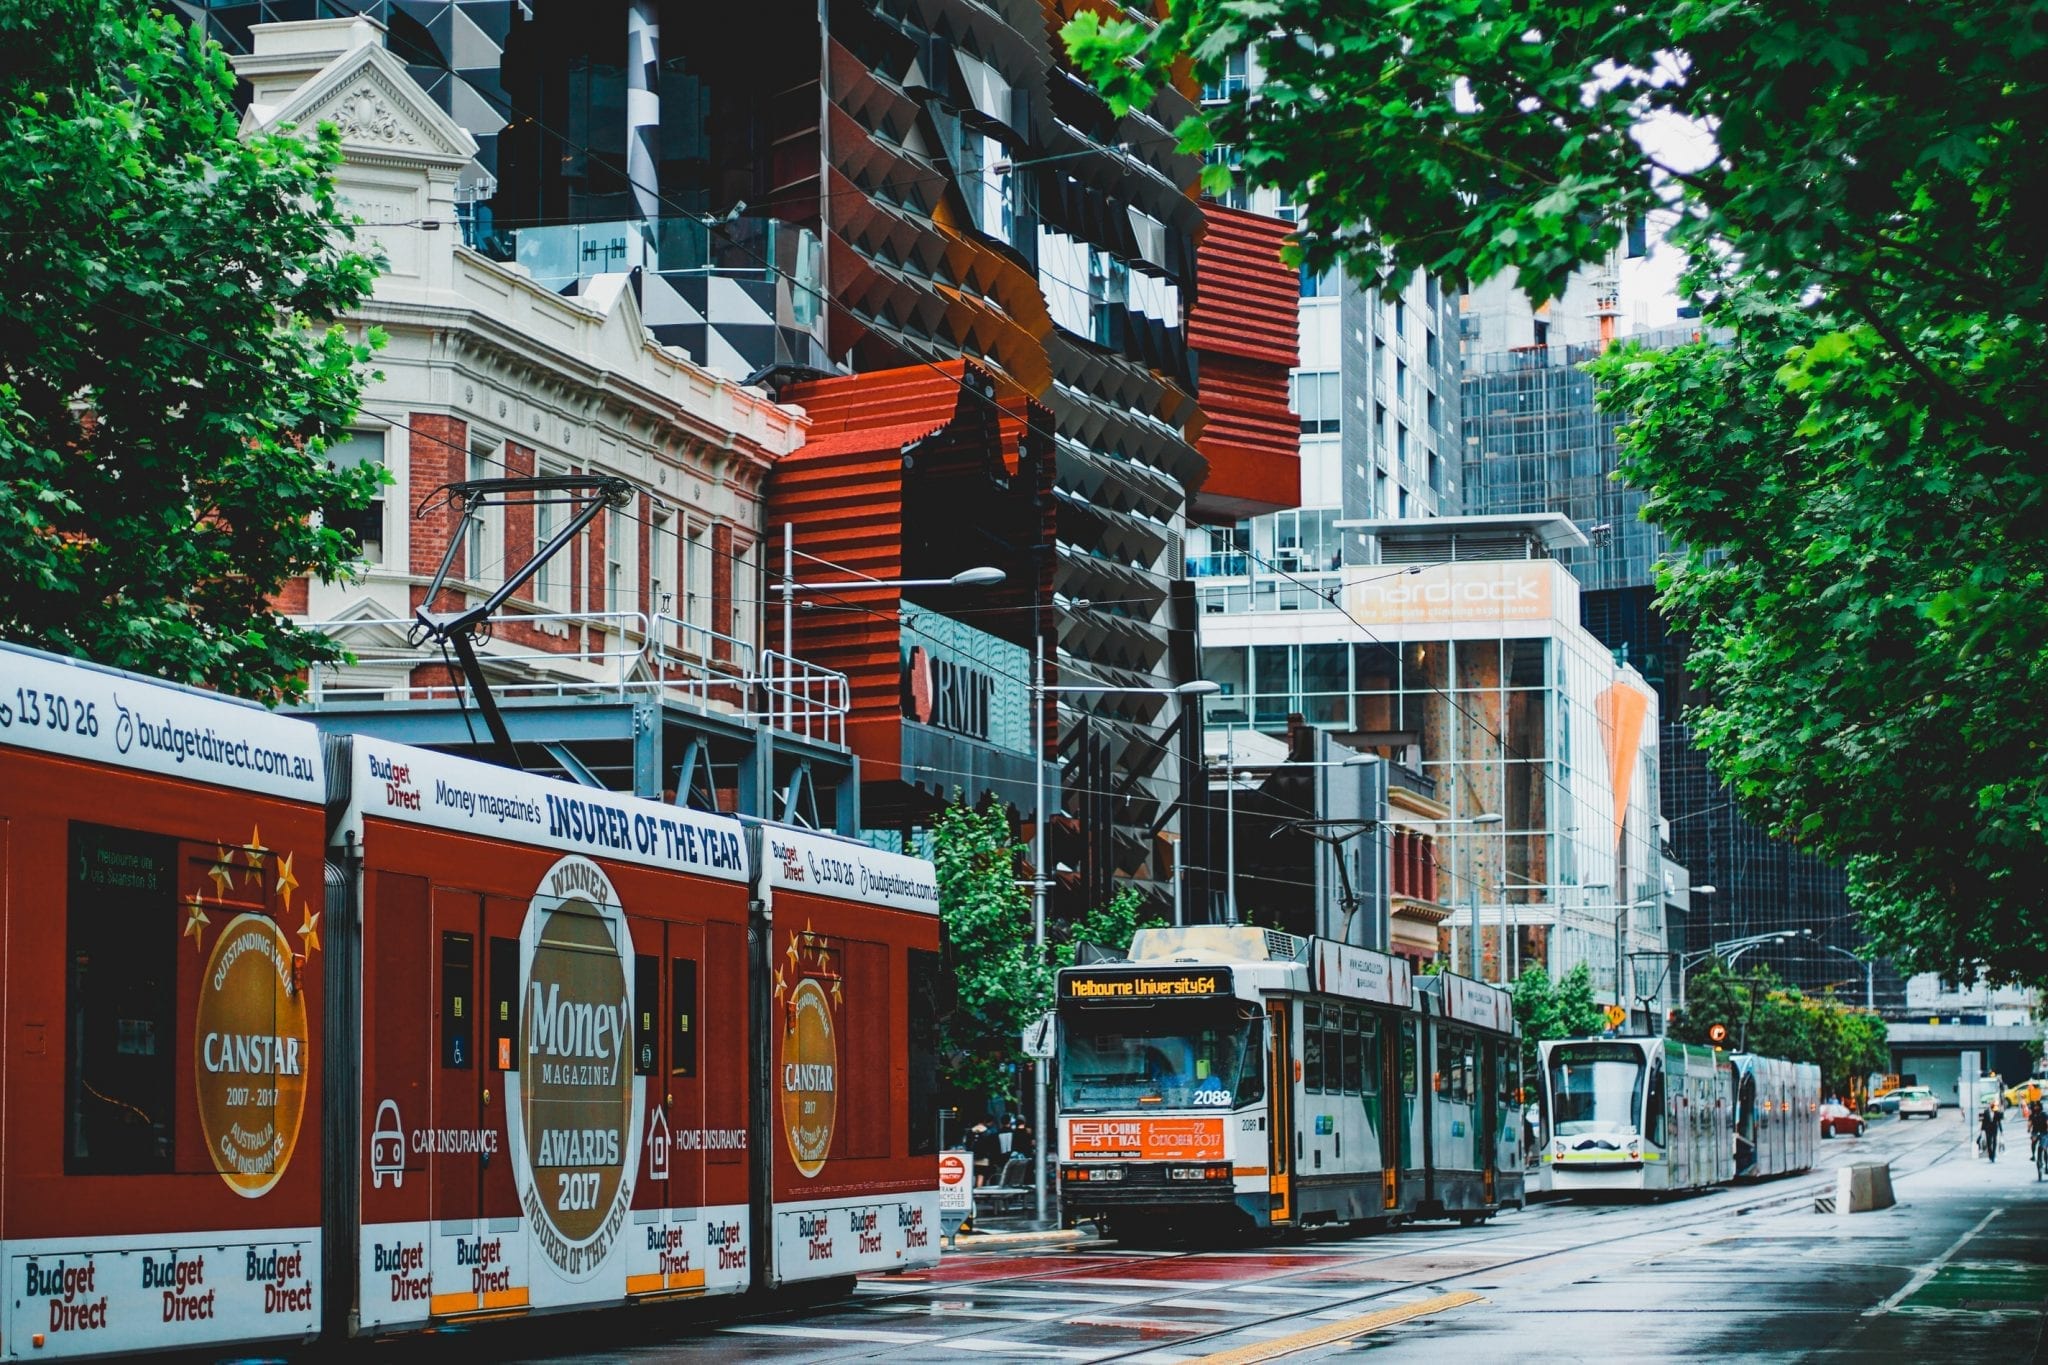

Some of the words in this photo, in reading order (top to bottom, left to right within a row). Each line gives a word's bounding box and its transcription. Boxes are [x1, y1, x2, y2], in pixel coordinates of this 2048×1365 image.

[17, 687, 41, 726] 13
[44, 692, 70, 731] 30
[74, 700, 99, 737] 26
[937, 658, 992, 742] RMIT
[136, 713, 315, 782] budgetdirect.com.au
[369, 754, 412, 785] Budget
[386, 782, 421, 811] Direct
[436, 779, 475, 818] Money
[477, 795, 541, 824] magazine's
[546, 793, 632, 850] INSURER
[633, 814, 658, 856] OF
[660, 820, 697, 863] THE
[698, 828, 742, 871] YEAR
[772, 840, 798, 864] Budget
[783, 862, 805, 882] Direct
[821, 858, 832, 882] 13
[832, 860, 843, 883] 30
[844, 863, 855, 886] 26
[551, 863, 609, 911] WINNER
[214, 932, 271, 991] OUTSTANDING
[270, 945, 294, 998] VALUE
[1071, 980, 1133, 996] Melbourne
[530, 981, 629, 1086] Money
[203, 1032, 299, 1075] CANSTAR
[543, 1064, 609, 1086] MAGAZINE
[785, 1063, 834, 1092] CANSTAR
[226, 1087, 249, 1106] 2007
[256, 1088, 279, 1106] 2017
[804, 1101, 817, 1115] 2017
[1193, 1090, 1231, 1105] 2089
[231, 1121, 274, 1151] AUSTRALIA
[1072, 1123, 1142, 1135] MELBOURNE
[1241, 1119, 1256, 1131] 2089
[220, 1134, 238, 1167] CAR
[237, 1132, 285, 1175] INSURANCE
[412, 1129, 436, 1153] CAR
[437, 1129, 498, 1153] INSURANCE
[538, 1129, 619, 1166] AWARDS
[676, 1129, 701, 1151] HOME
[702, 1129, 747, 1150] INSURANCE
[1072, 1135, 1142, 1146] FESTIVAL
[1194, 1134, 1221, 1147] 2017
[945, 1159, 958, 1167] NO
[558, 1172, 601, 1211] 2017
[940, 1200, 965, 1208] CEPTED
[523, 1182, 568, 1272] INSURER
[569, 1247, 583, 1275] OF
[584, 1231, 608, 1271] THE
[604, 1179, 631, 1245] YEAR
[799, 1215, 828, 1243] Budget
[850, 1211, 877, 1238] Budget
[899, 1206, 923, 1232] Budget
[647, 1224, 683, 1255] Budget
[707, 1219, 741, 1250] Budget
[859, 1232, 882, 1254] Direct
[906, 1228, 928, 1249] Direct
[375, 1241, 423, 1278] Budget
[457, 1237, 501, 1270] Budget
[659, 1250, 690, 1275] Direct
[718, 1246, 746, 1270] Direct
[808, 1238, 833, 1261] Direct
[27, 1260, 95, 1302] Budget
[143, 1254, 204, 1294] Budget
[246, 1249, 302, 1287] Budget
[472, 1267, 510, 1294] Direct
[265, 1281, 312, 1313] Direct
[391, 1273, 433, 1302] Direct
[50, 1297, 107, 1332] Direct
[163, 1289, 214, 1322] Direct
